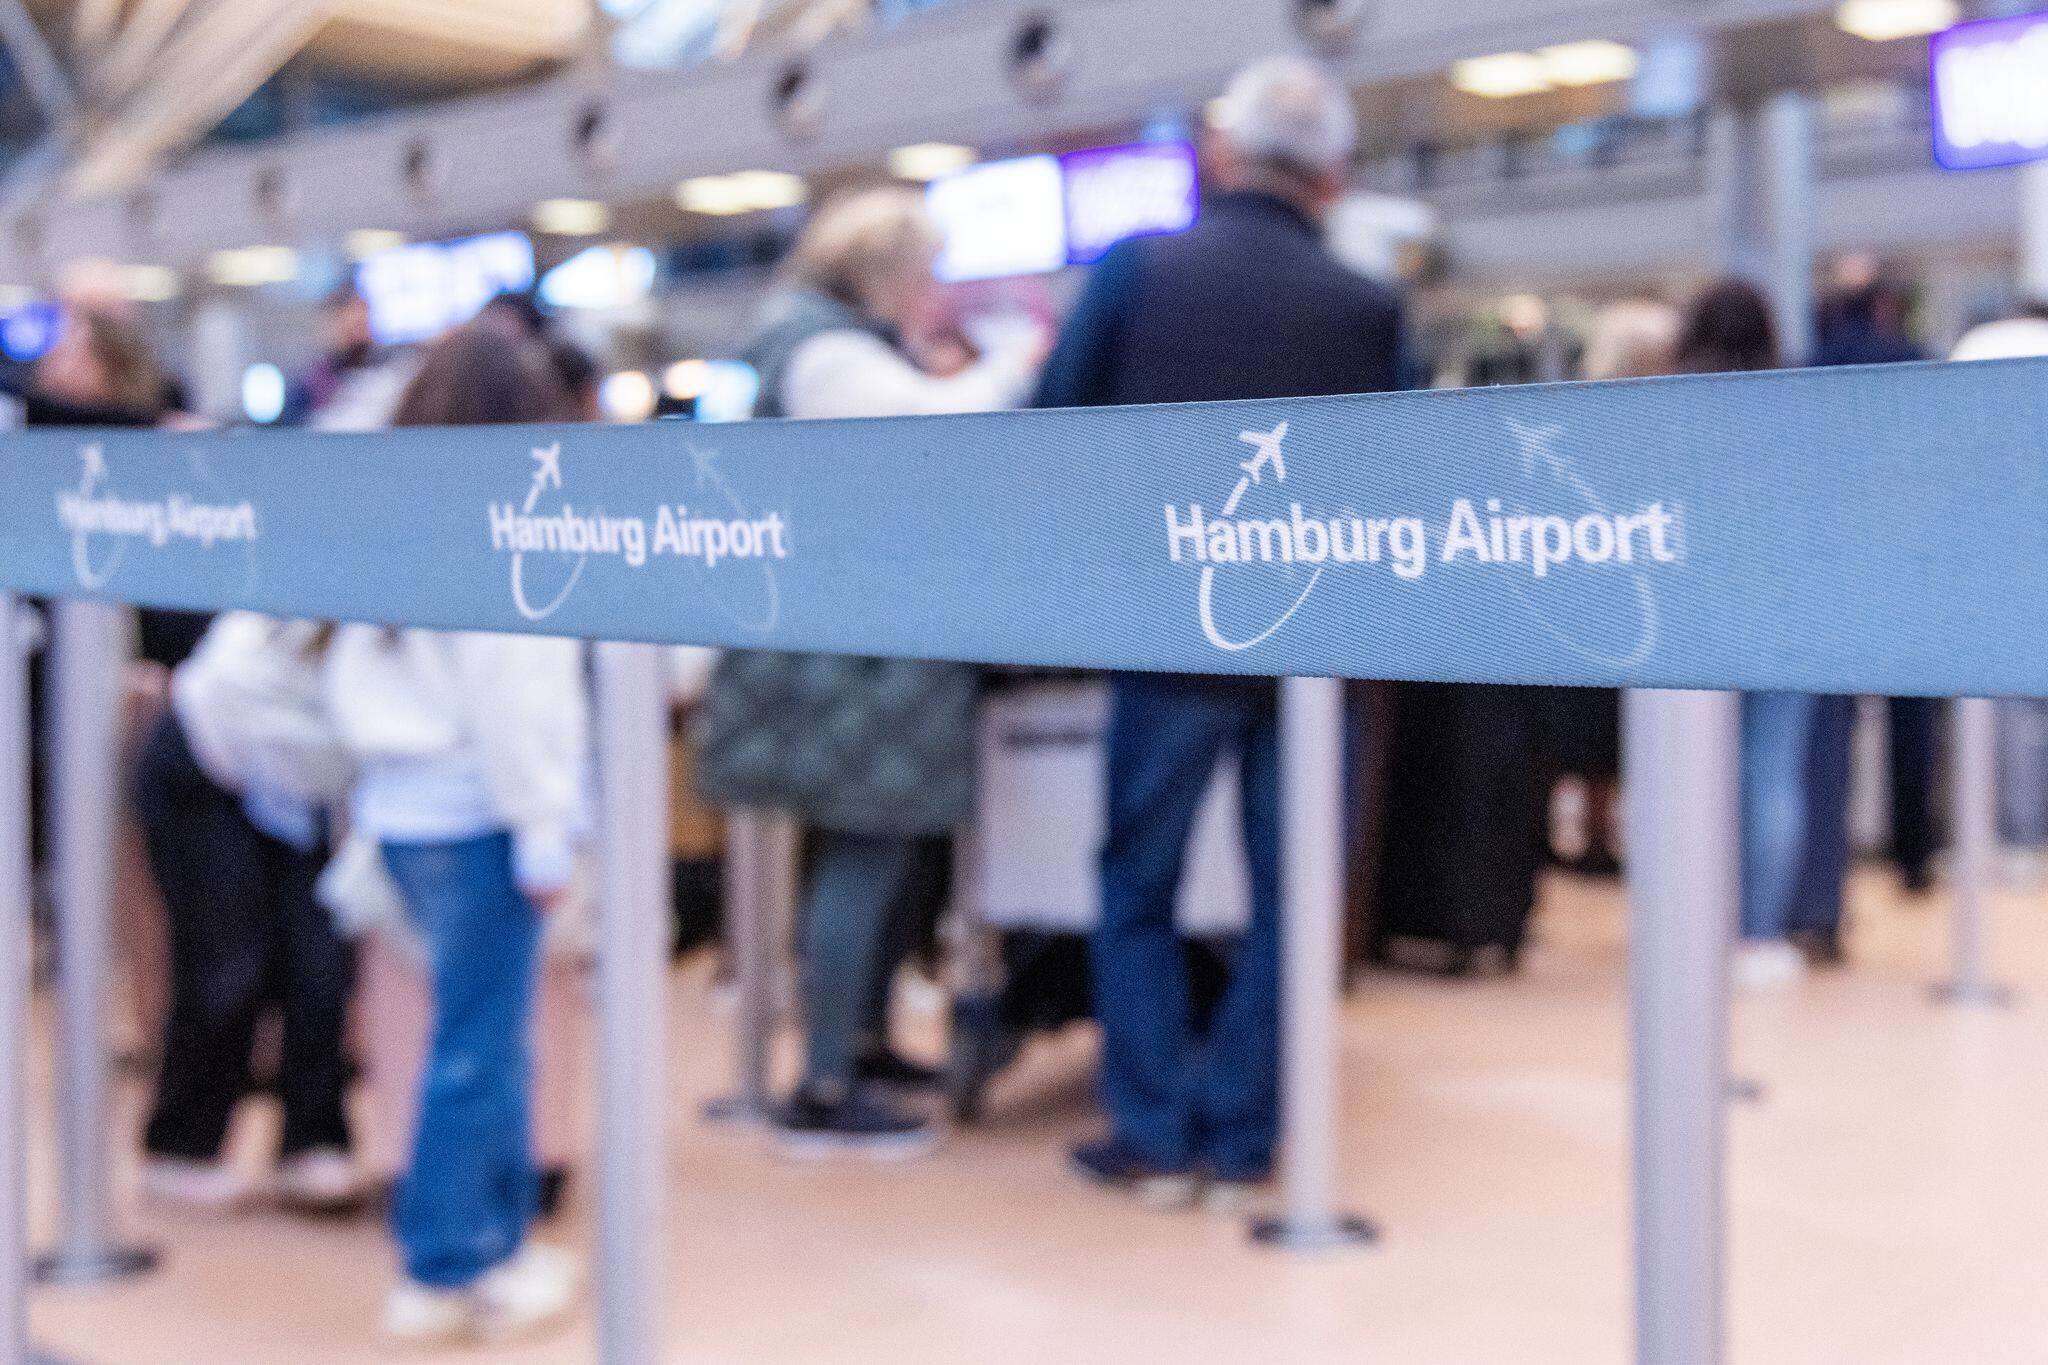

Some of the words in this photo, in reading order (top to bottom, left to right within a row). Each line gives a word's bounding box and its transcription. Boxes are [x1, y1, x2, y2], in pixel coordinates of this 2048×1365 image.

[489, 503, 646, 567] Hamburg
[652, 504, 787, 567] Airport
[1165, 502, 1425, 579] Hamburg
[1442, 499, 1675, 577] Airport
